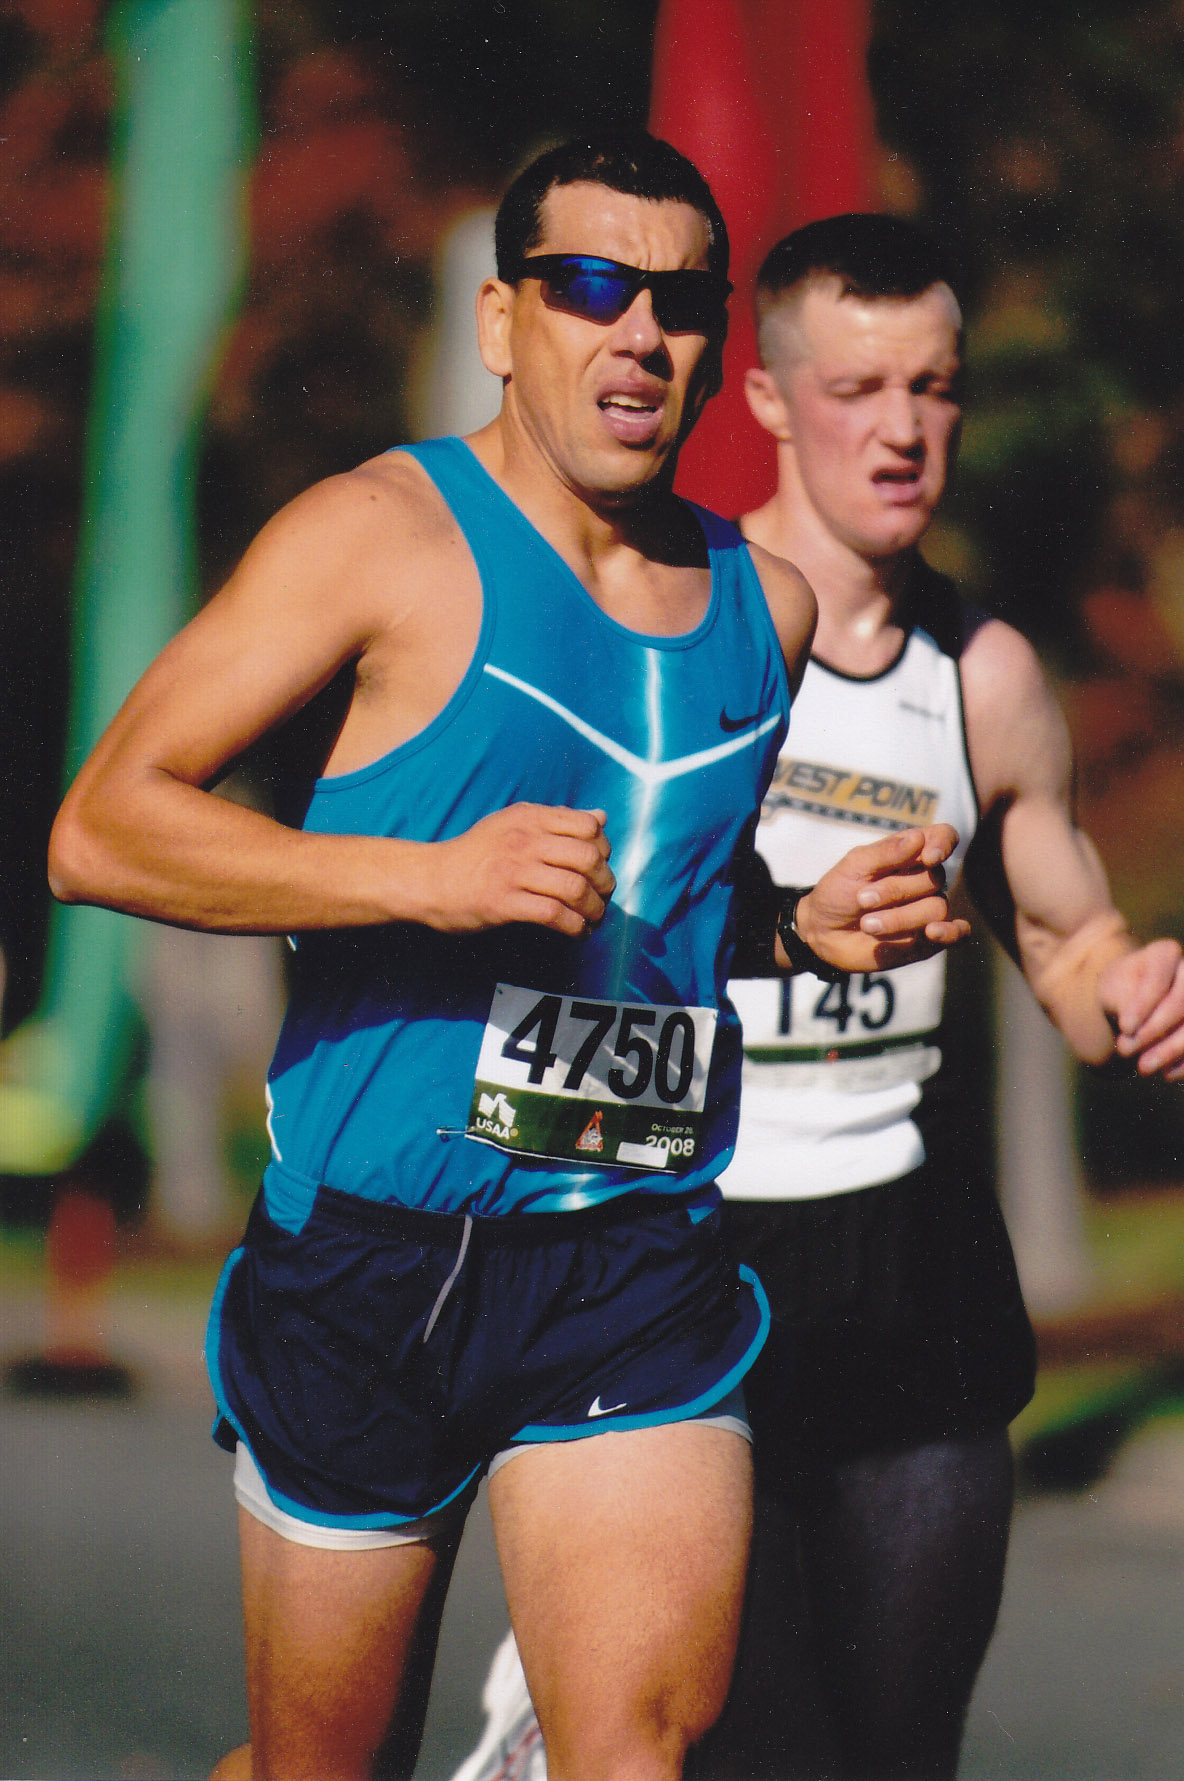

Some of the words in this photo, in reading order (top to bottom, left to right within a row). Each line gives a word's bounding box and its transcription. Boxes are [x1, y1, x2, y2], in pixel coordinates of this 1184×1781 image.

[848, 774, 939, 817] POINT
[779, 973, 895, 1035] 145
[501, 995, 695, 1103] 4750
[476, 1117, 510, 1139] USAA
[645, 1135, 695, 1157] 2008
